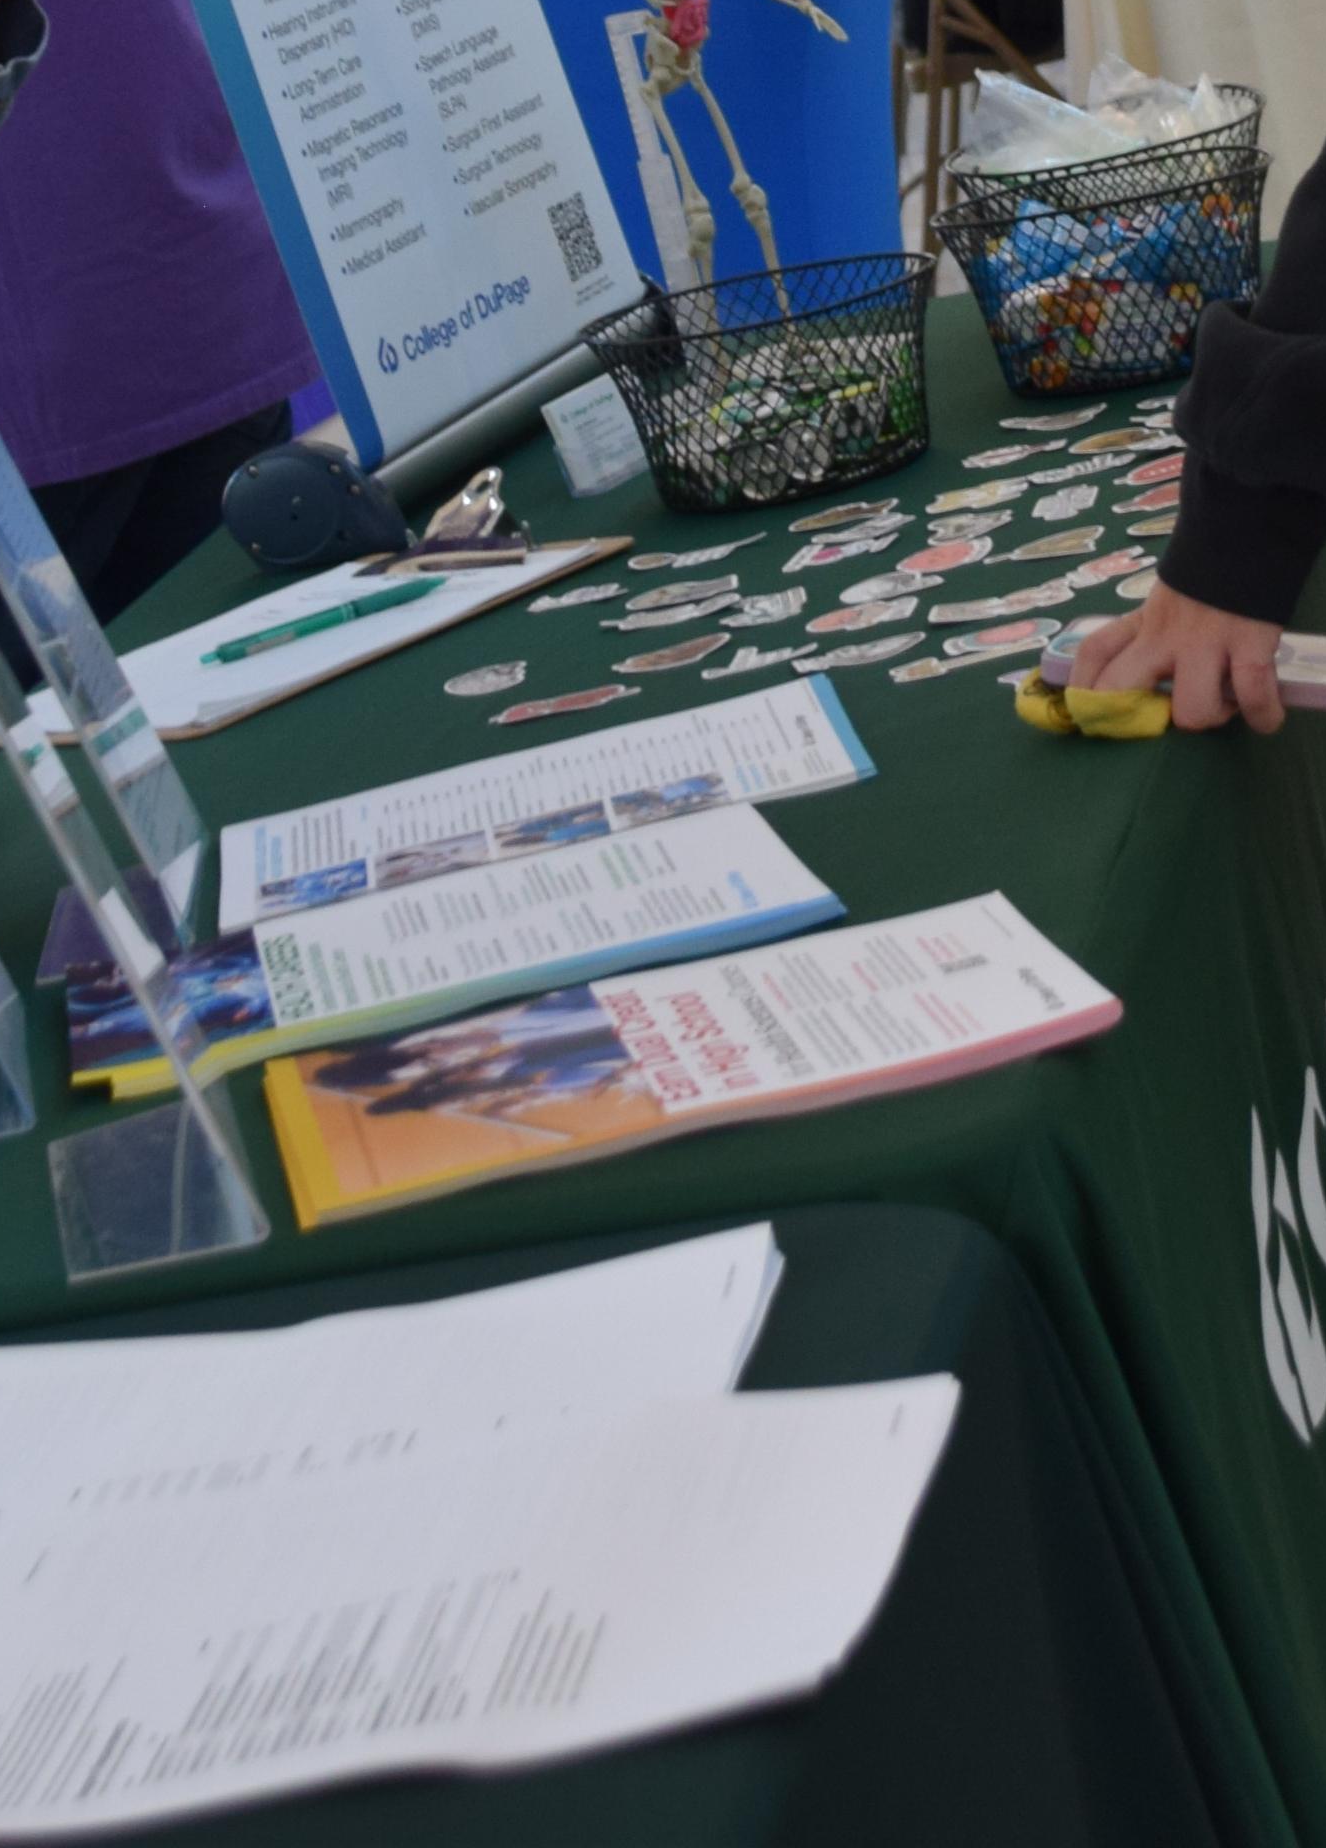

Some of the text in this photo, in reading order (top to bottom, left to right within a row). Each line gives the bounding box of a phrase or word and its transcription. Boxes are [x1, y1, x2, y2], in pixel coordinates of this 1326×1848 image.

[267, 14, 307, 40] Hearing
[452, 26, 498, 56] Language
[338, 56, 362, 76] Care
[473, 44, 515, 73] Assistant
[307, 102, 403, 158] Magnetic Resonance
[355, 130, 408, 162] Technology
[447, 93, 543, 153] Surgical First Assistant
[458, 134, 542, 185] Surgical Technology
[346, 222, 426, 274] Medical Assistant
[404, 319, 457, 360] College
[460, 301, 474, 329] of
[475, 277, 529, 319] DuPage
[601, 990, 700, 1105] Earn Dual Credit
[664, 991, 759, 1093] in High School
